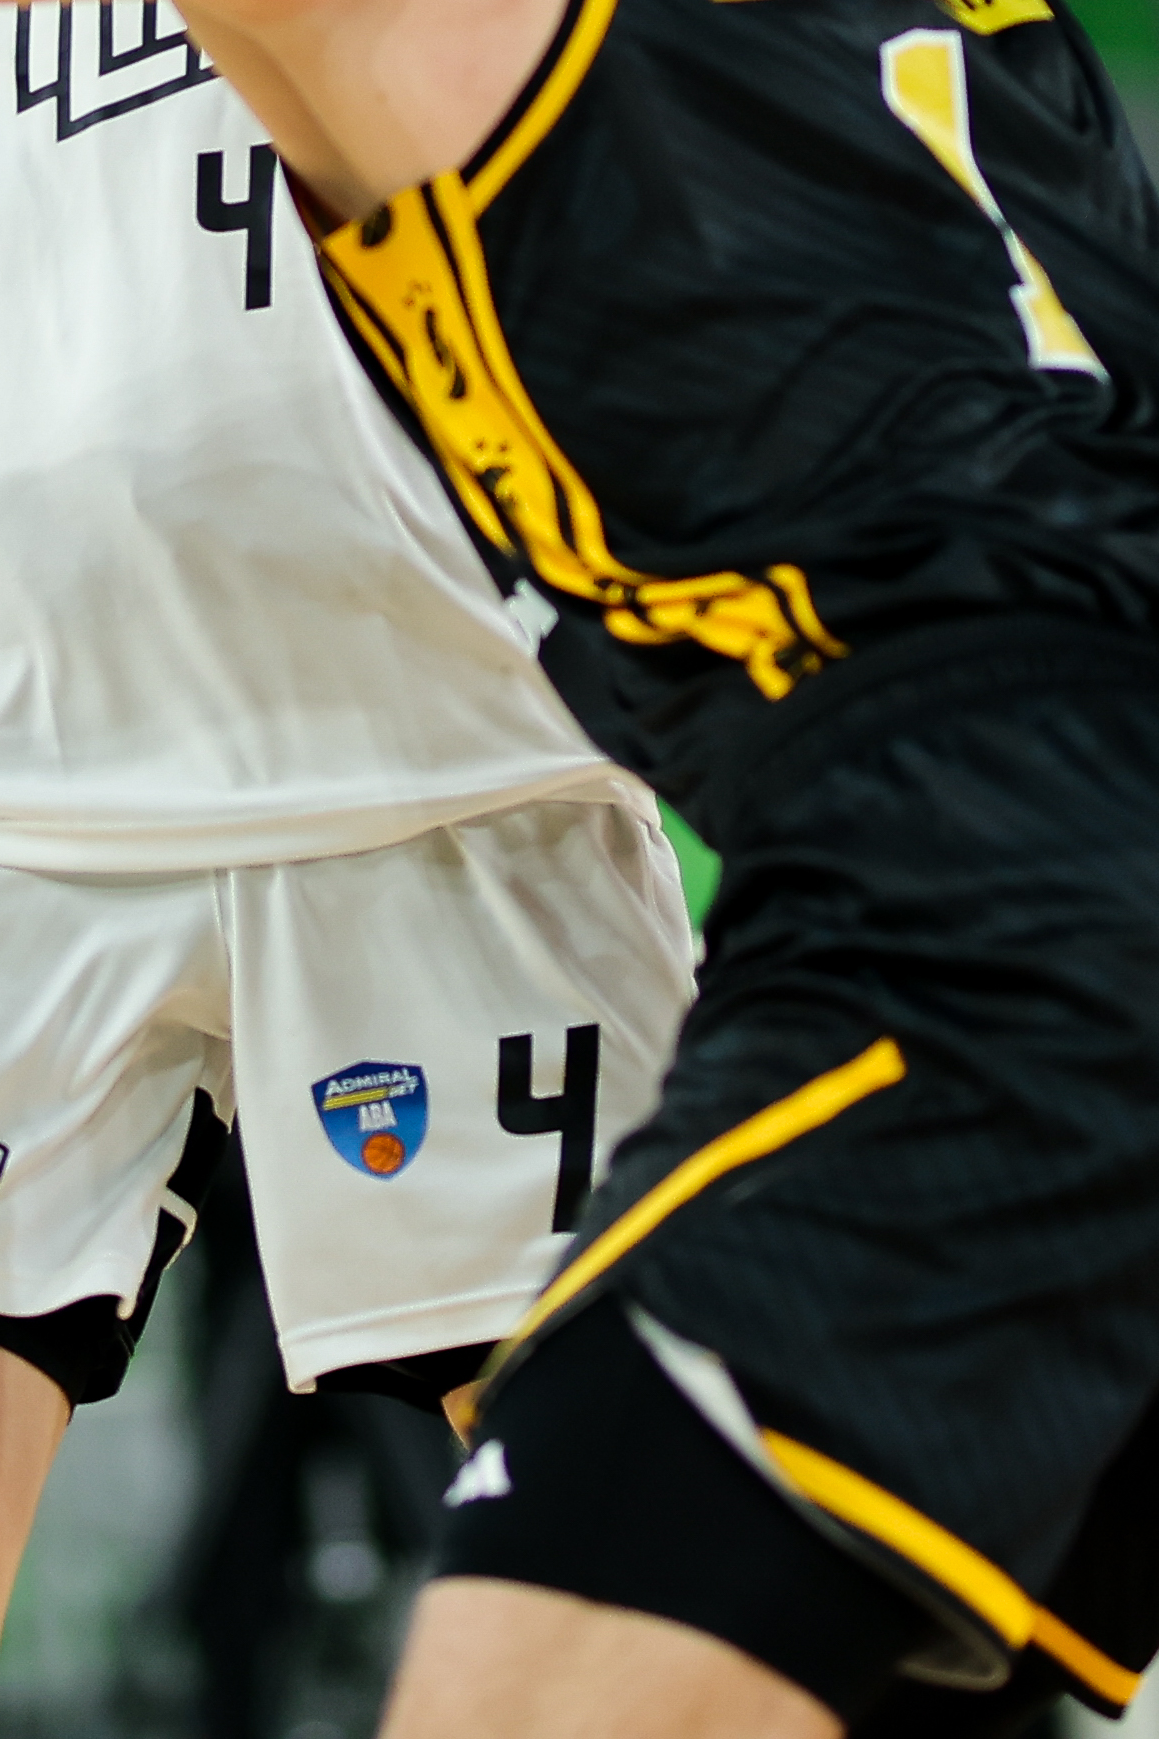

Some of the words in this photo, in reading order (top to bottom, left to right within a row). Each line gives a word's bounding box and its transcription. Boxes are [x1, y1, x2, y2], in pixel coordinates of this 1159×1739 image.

[196, 143, 276, 311] 4
[325, 1067, 420, 1097] ADMIRAL
[497, 1024, 600, 1233] 4
